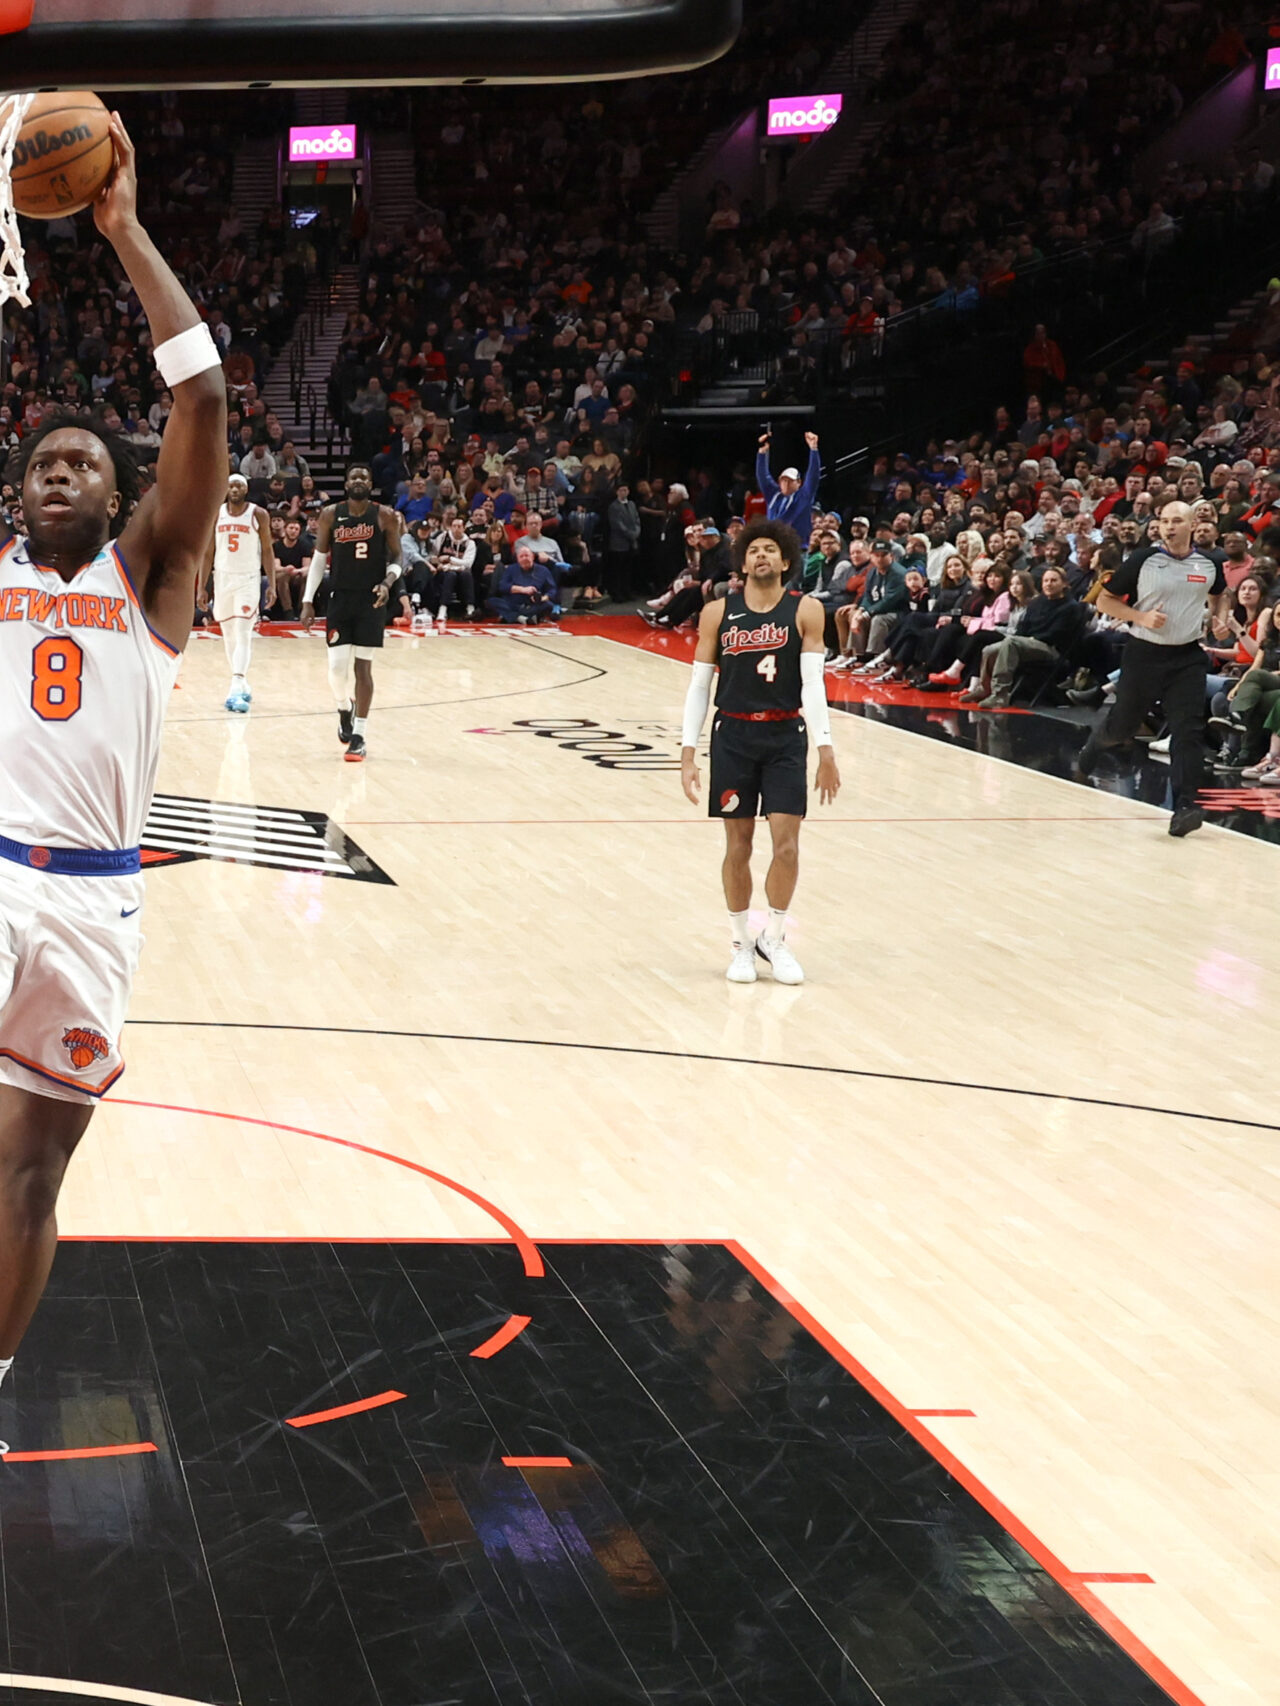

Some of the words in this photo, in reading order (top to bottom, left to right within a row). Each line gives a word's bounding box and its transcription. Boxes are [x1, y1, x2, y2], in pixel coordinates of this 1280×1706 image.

[292, 129, 353, 154] moda
[227, 534, 239, 552] 5
[355, 542, 368, 559] 2
[55, 592, 127, 633] YORK
[721, 622, 789, 649] ripcity
[31, 636, 83, 721] 8
[757, 654, 777, 682] 4
[63, 1027, 109, 1058] KNICKS
